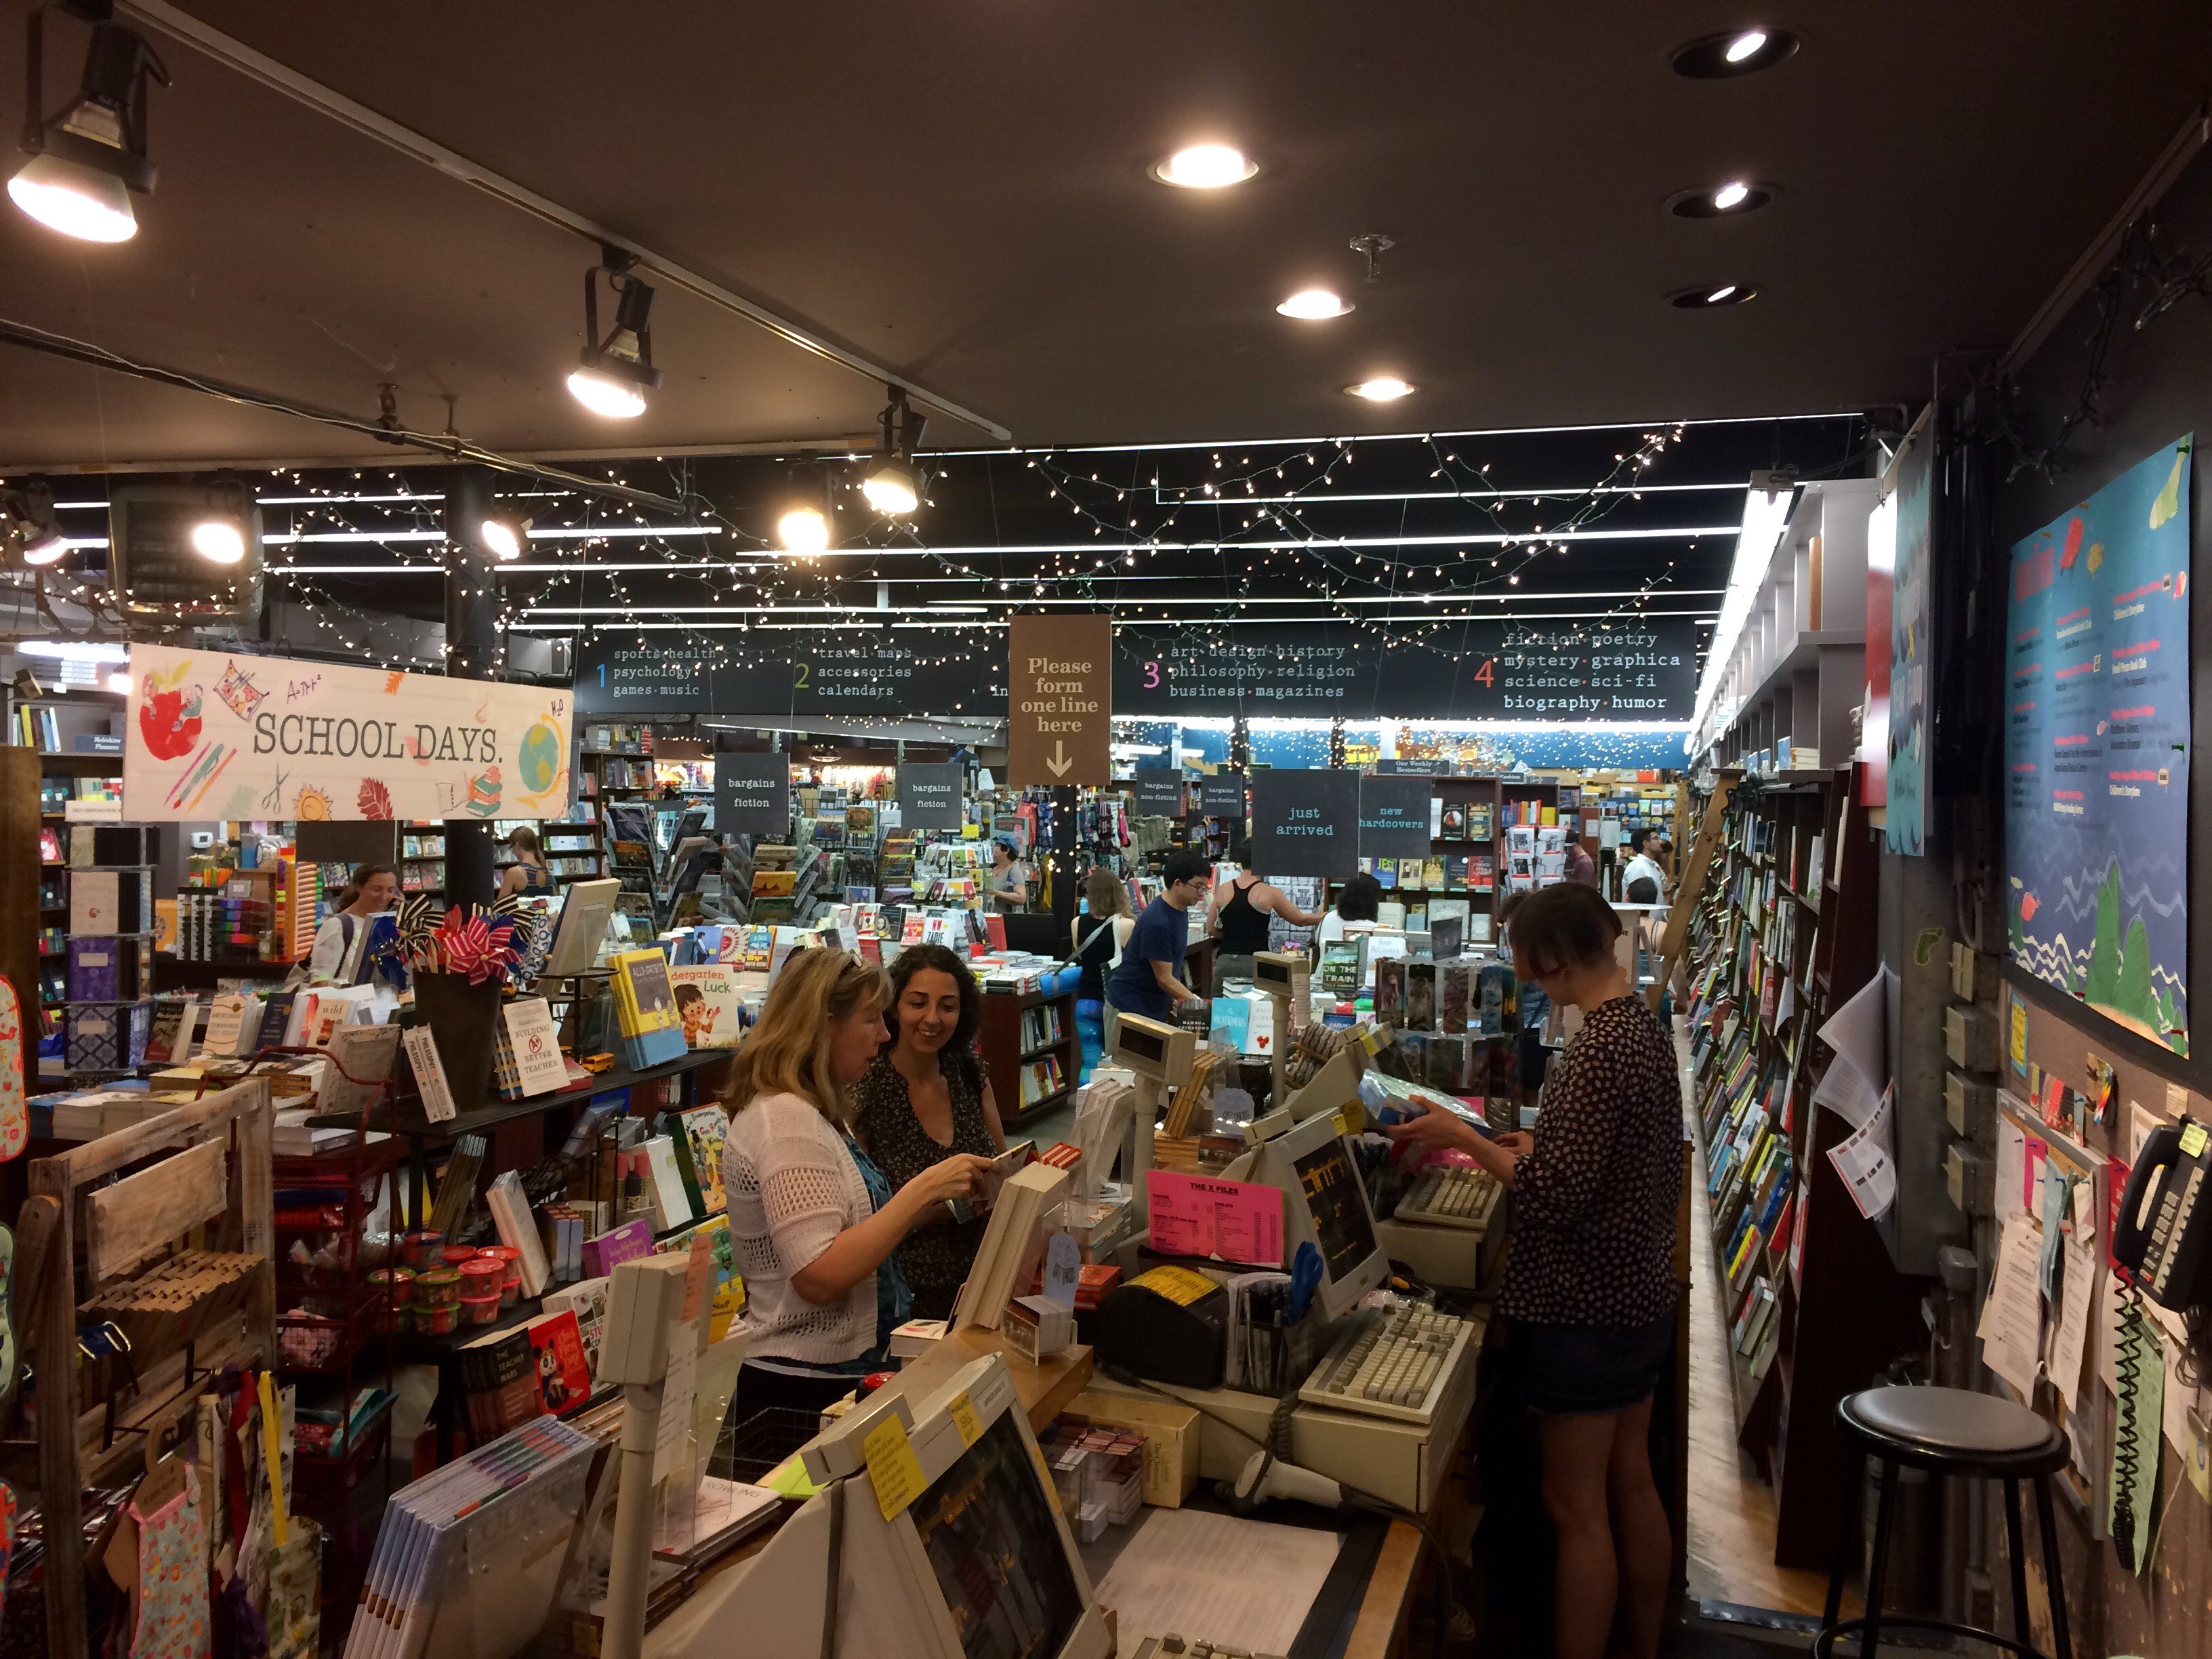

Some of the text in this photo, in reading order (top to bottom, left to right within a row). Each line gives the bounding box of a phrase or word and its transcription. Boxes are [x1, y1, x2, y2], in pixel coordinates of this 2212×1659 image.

[1505, 633, 1658, 648] fiction poetry
[614, 648, 716, 661] sports health
[819, 647, 912, 661] travel maps
[1170, 644, 1346, 660] art design history
[1027, 657, 1092, 674] Please
[1504, 653, 1681, 669] mystery graphica
[596, 663, 606, 688] 1
[613, 665, 692, 680] psychology
[794, 663, 810, 689] 2
[818, 665, 912, 677] accessories
[1143, 662, 1160, 689] 3
[1170, 663, 1355, 680] philosophy religion
[1474, 660, 1494, 689] 4
[1036, 677, 1084, 693] form
[1504, 674, 1657, 687] science sci-fi
[613, 684, 699, 697] games music
[818, 684, 894, 696] calendars
[1170, 684, 1344, 699] business magazines
[1021, 696, 1099, 713] one line
[1504, 695, 1667, 711] biography humor
[1037, 716, 1082, 732] here
[253, 712, 503, 764] SCHOOL DAYS.
[728, 779, 775, 789] bargains
[913, 783, 951, 794] bargains
[1145, 782, 1174, 790] bargains
[734, 798, 770, 807] fiction
[917, 800, 947, 808] fiction
[1288, 807, 1320, 821] just
[1358, 818, 1424, 828] hardcovers
[1276, 825, 1334, 836] arrived
[1340, 965, 1357, 973] THE
[1324, 975, 1355, 983] TRAIN
[703, 981, 731, 994] Luck
[322, 1004, 343, 1014] wild
[515, 1025, 550, 1038] BUILDING
[408, 1040, 423, 1072] PHILOSOPHY
[421, 1038, 436, 1069] PHILOSOPHY
[525, 1050, 552, 1063] BETTER
[525, 1061, 558, 1073] TEACHER
[1190, 1182, 1206, 1191] THE
[1216, 1186, 1239, 1195] FILES
